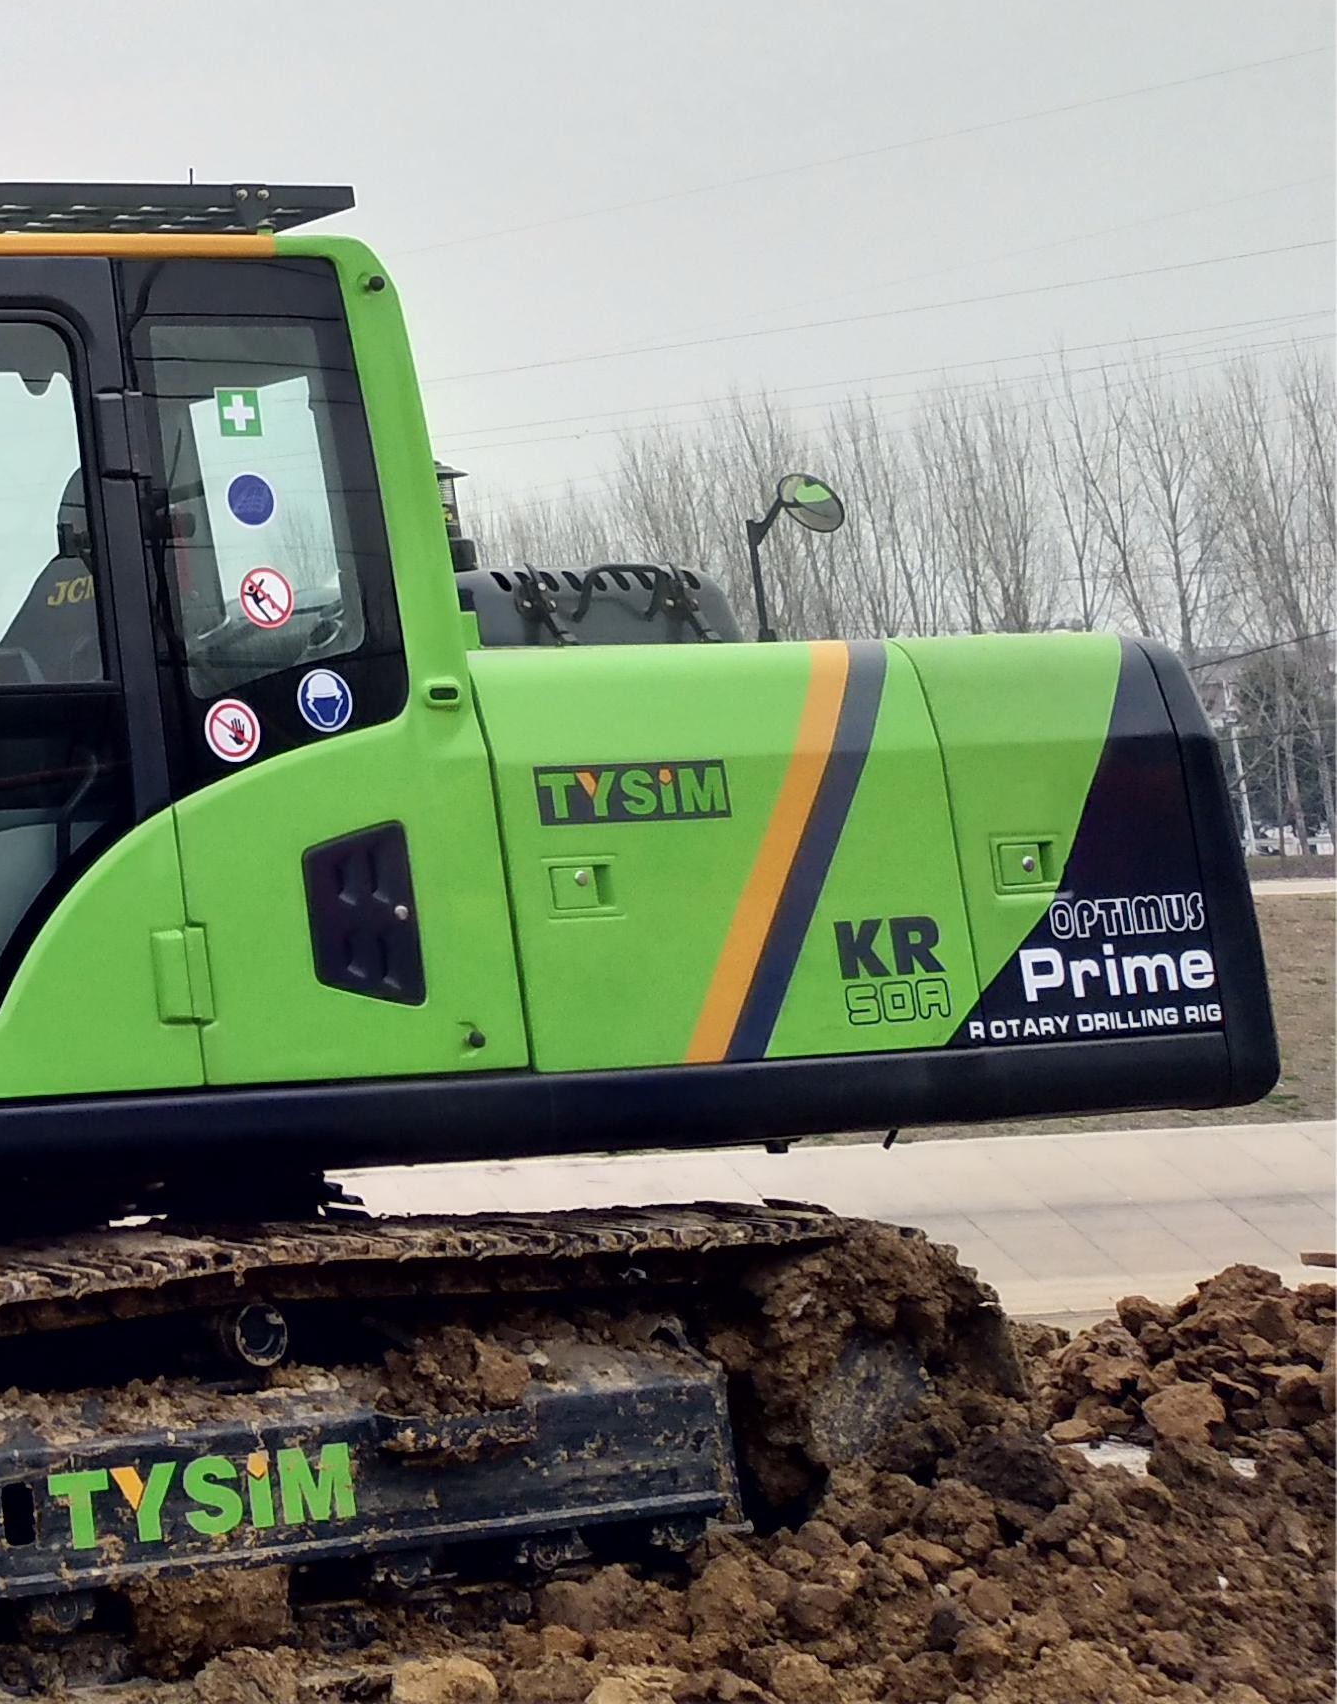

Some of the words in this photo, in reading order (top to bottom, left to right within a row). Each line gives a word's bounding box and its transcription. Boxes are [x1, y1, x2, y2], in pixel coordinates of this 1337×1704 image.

[1049, 892, 1205, 939] OPTIMUS
[833, 916, 946, 980] KR
[1019, 943, 1216, 1002] Prime
[1077, 1007, 1179, 1032] DRILLING
[1184, 1003, 1222, 1023] RIG
